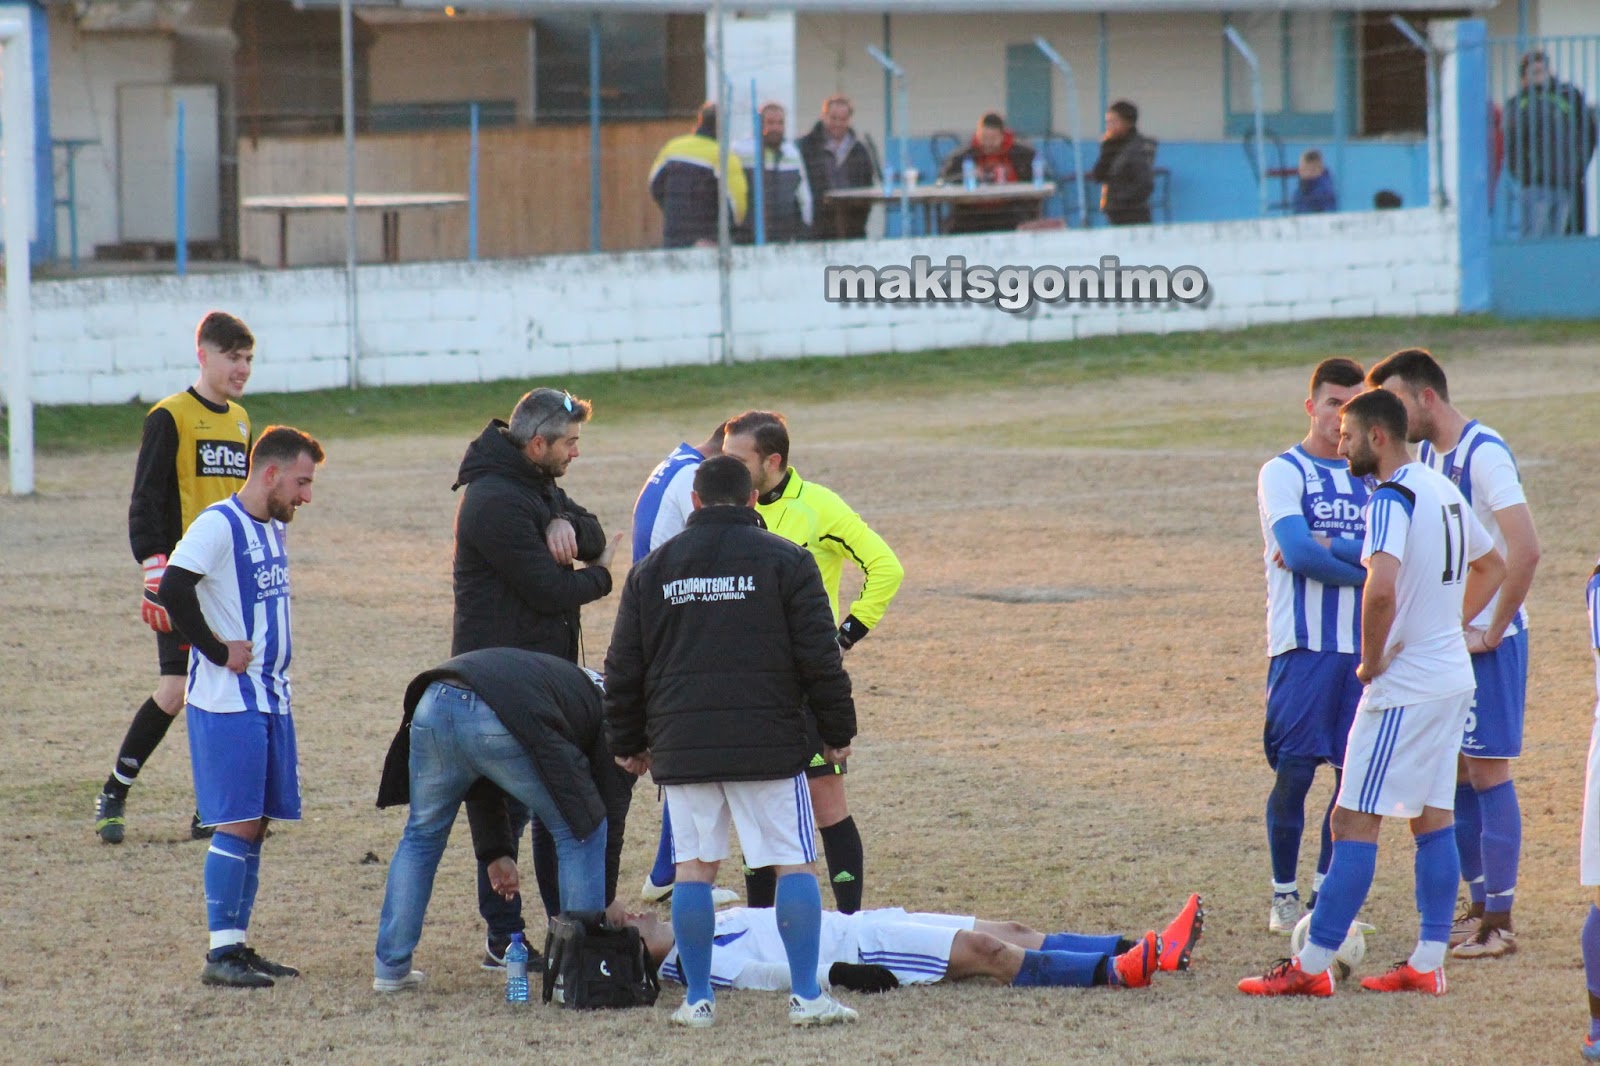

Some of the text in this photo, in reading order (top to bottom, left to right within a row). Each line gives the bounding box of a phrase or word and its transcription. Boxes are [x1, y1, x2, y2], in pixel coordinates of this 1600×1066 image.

[1313, 520, 1345, 530] CASINO
[1441, 503, 1464, 584] 17
[701, 591, 746, 602] ΑΛΟΥΜΙΝΙΑ
